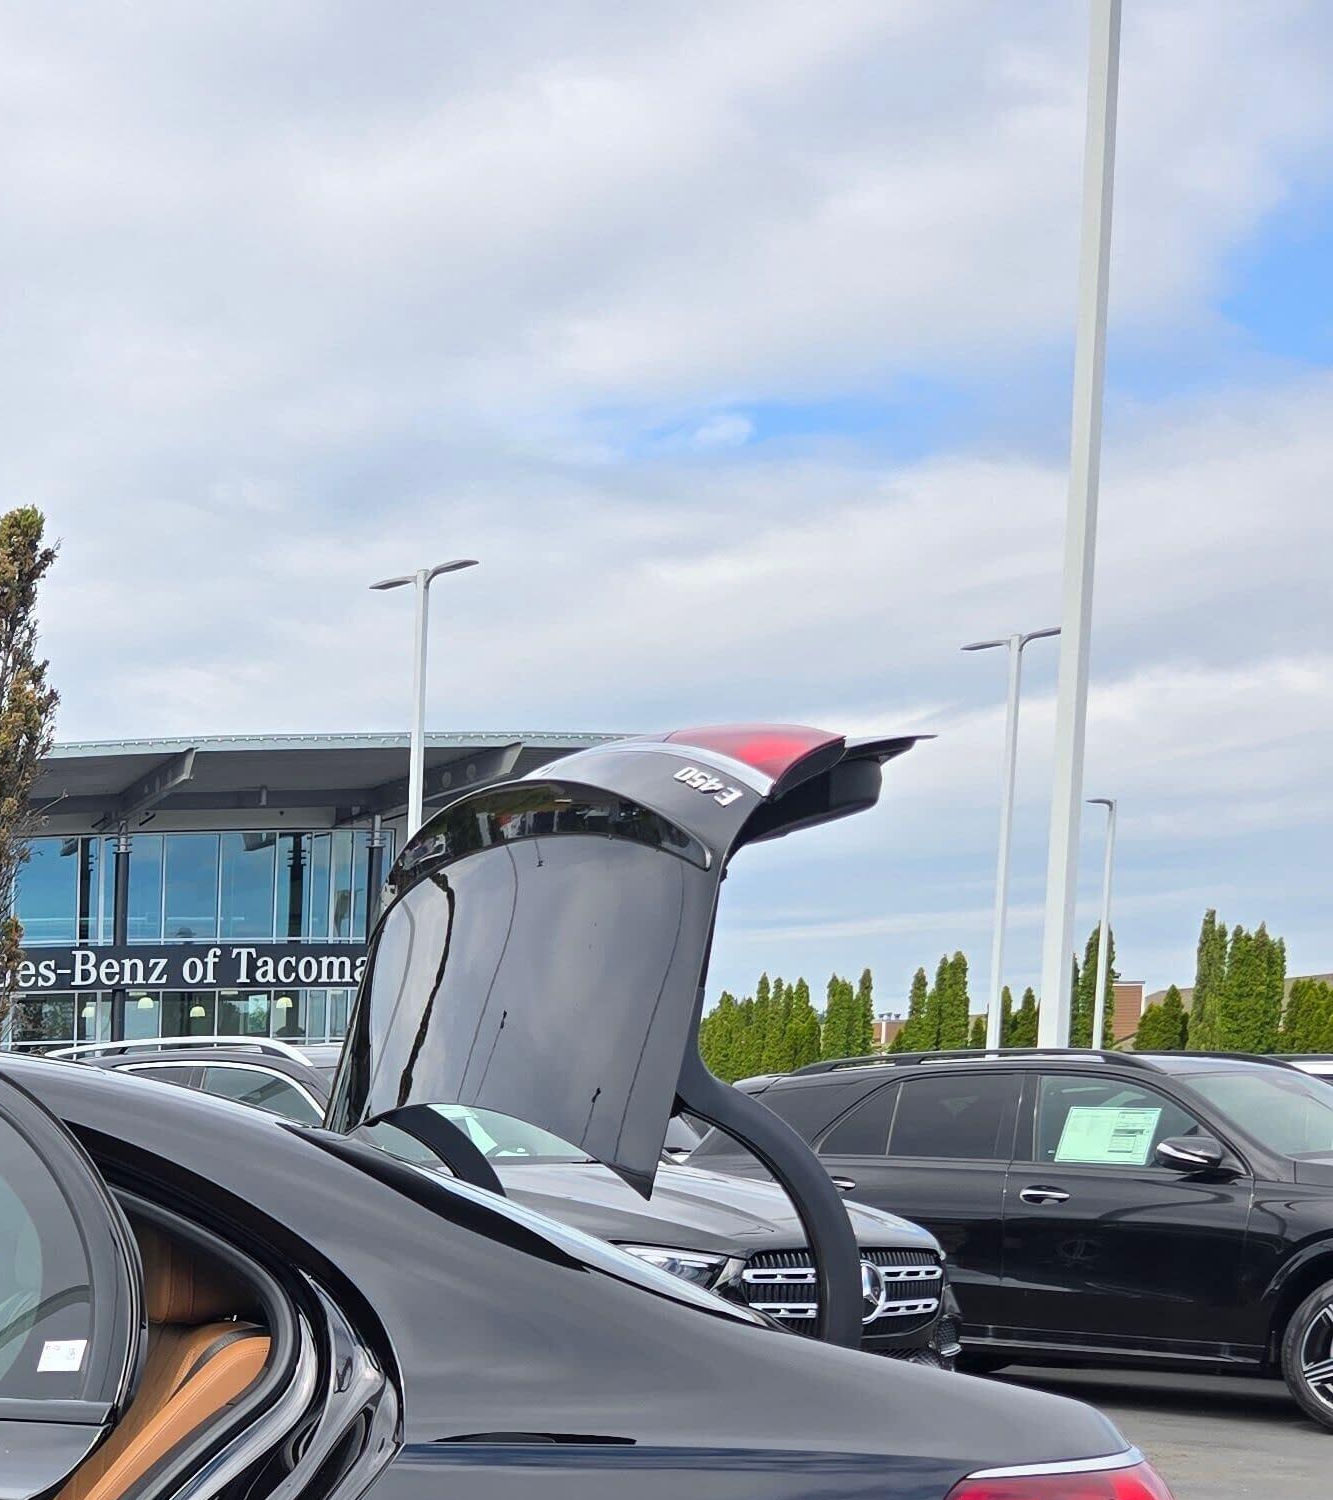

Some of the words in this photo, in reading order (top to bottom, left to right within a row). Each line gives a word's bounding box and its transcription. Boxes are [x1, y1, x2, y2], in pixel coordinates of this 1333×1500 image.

[673, 767, 724, 793] 450
[713, 787, 744, 806] E
[183, 948, 221, 984] of
[231, 947, 368, 983] Tacoma
